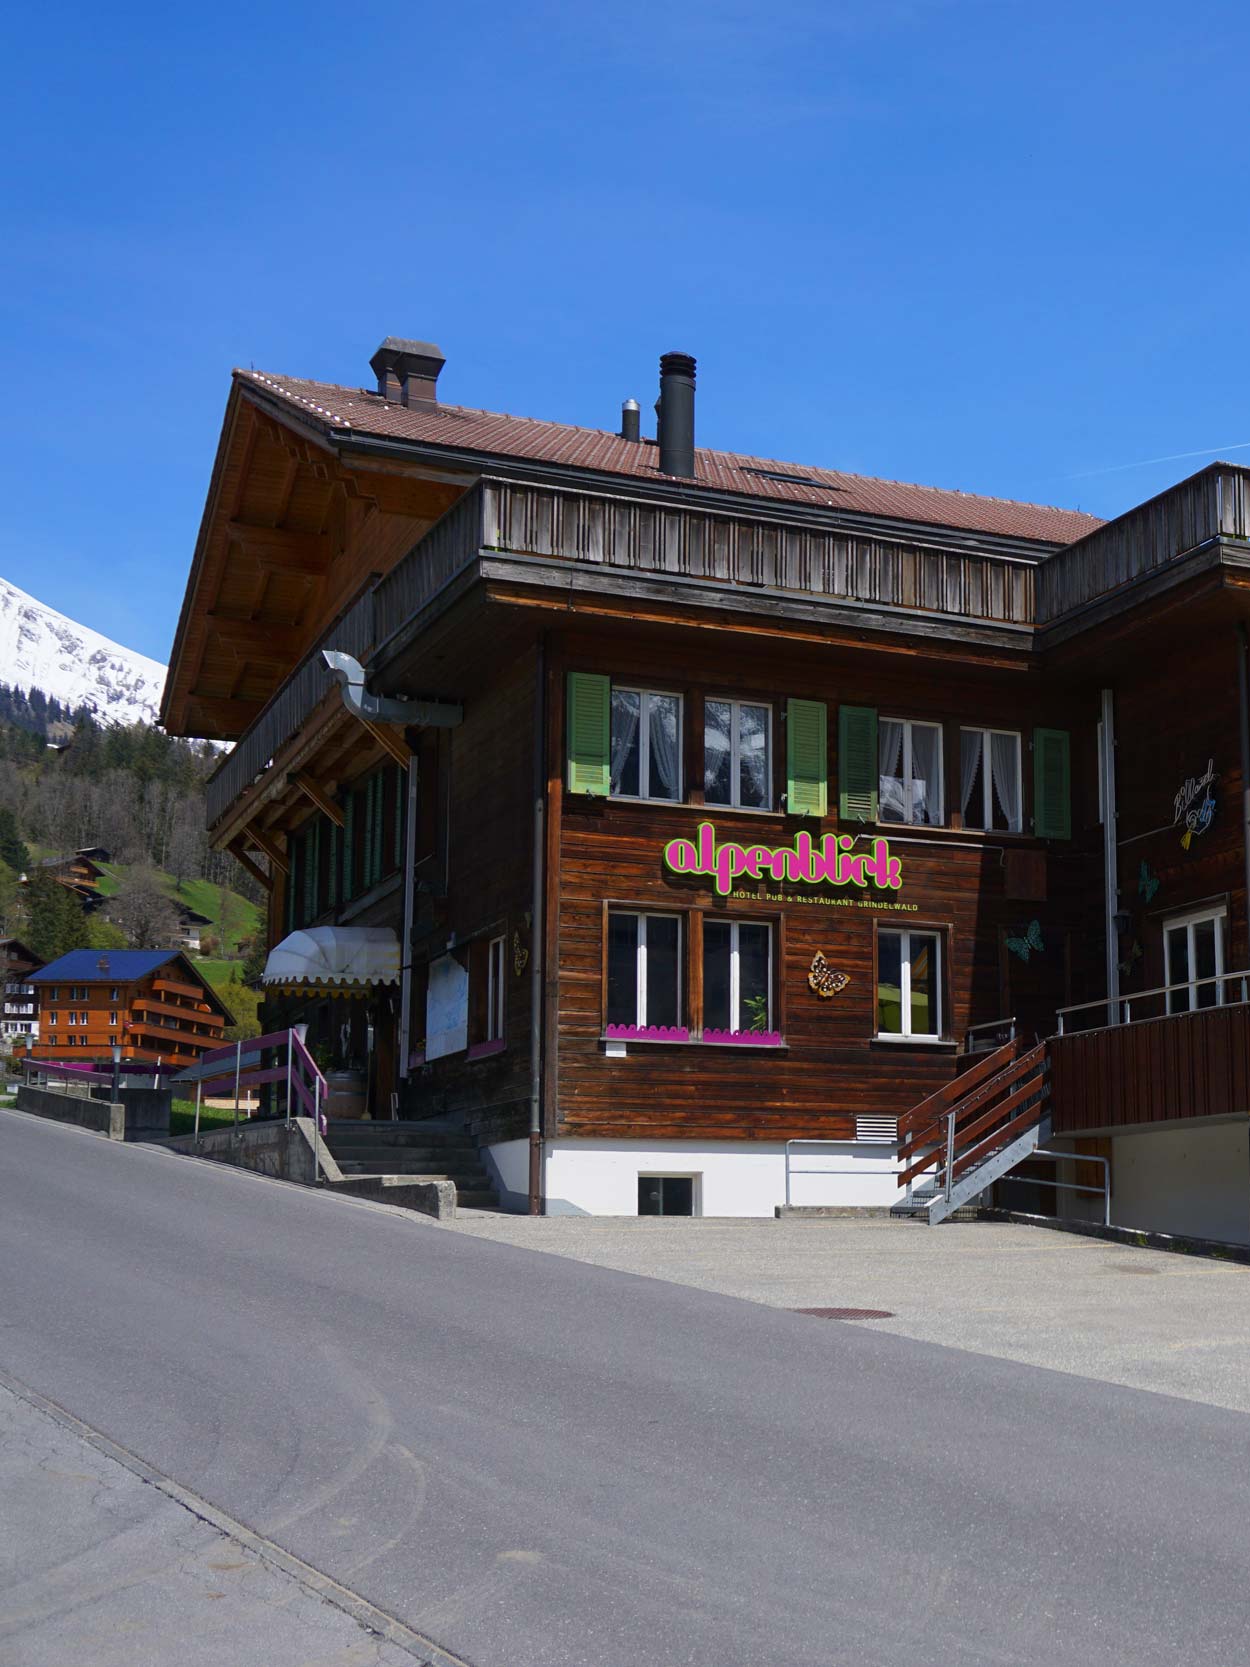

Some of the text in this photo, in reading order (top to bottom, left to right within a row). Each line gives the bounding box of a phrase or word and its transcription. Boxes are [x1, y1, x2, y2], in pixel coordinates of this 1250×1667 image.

[664, 822, 902, 896] alpenblick
[733, 891, 762, 901] HOTEL
[766, 893, 783, 902] PUB
[797, 895, 854, 907] RESTAURANT
[857, 900, 918, 912] GRINDELWALD
